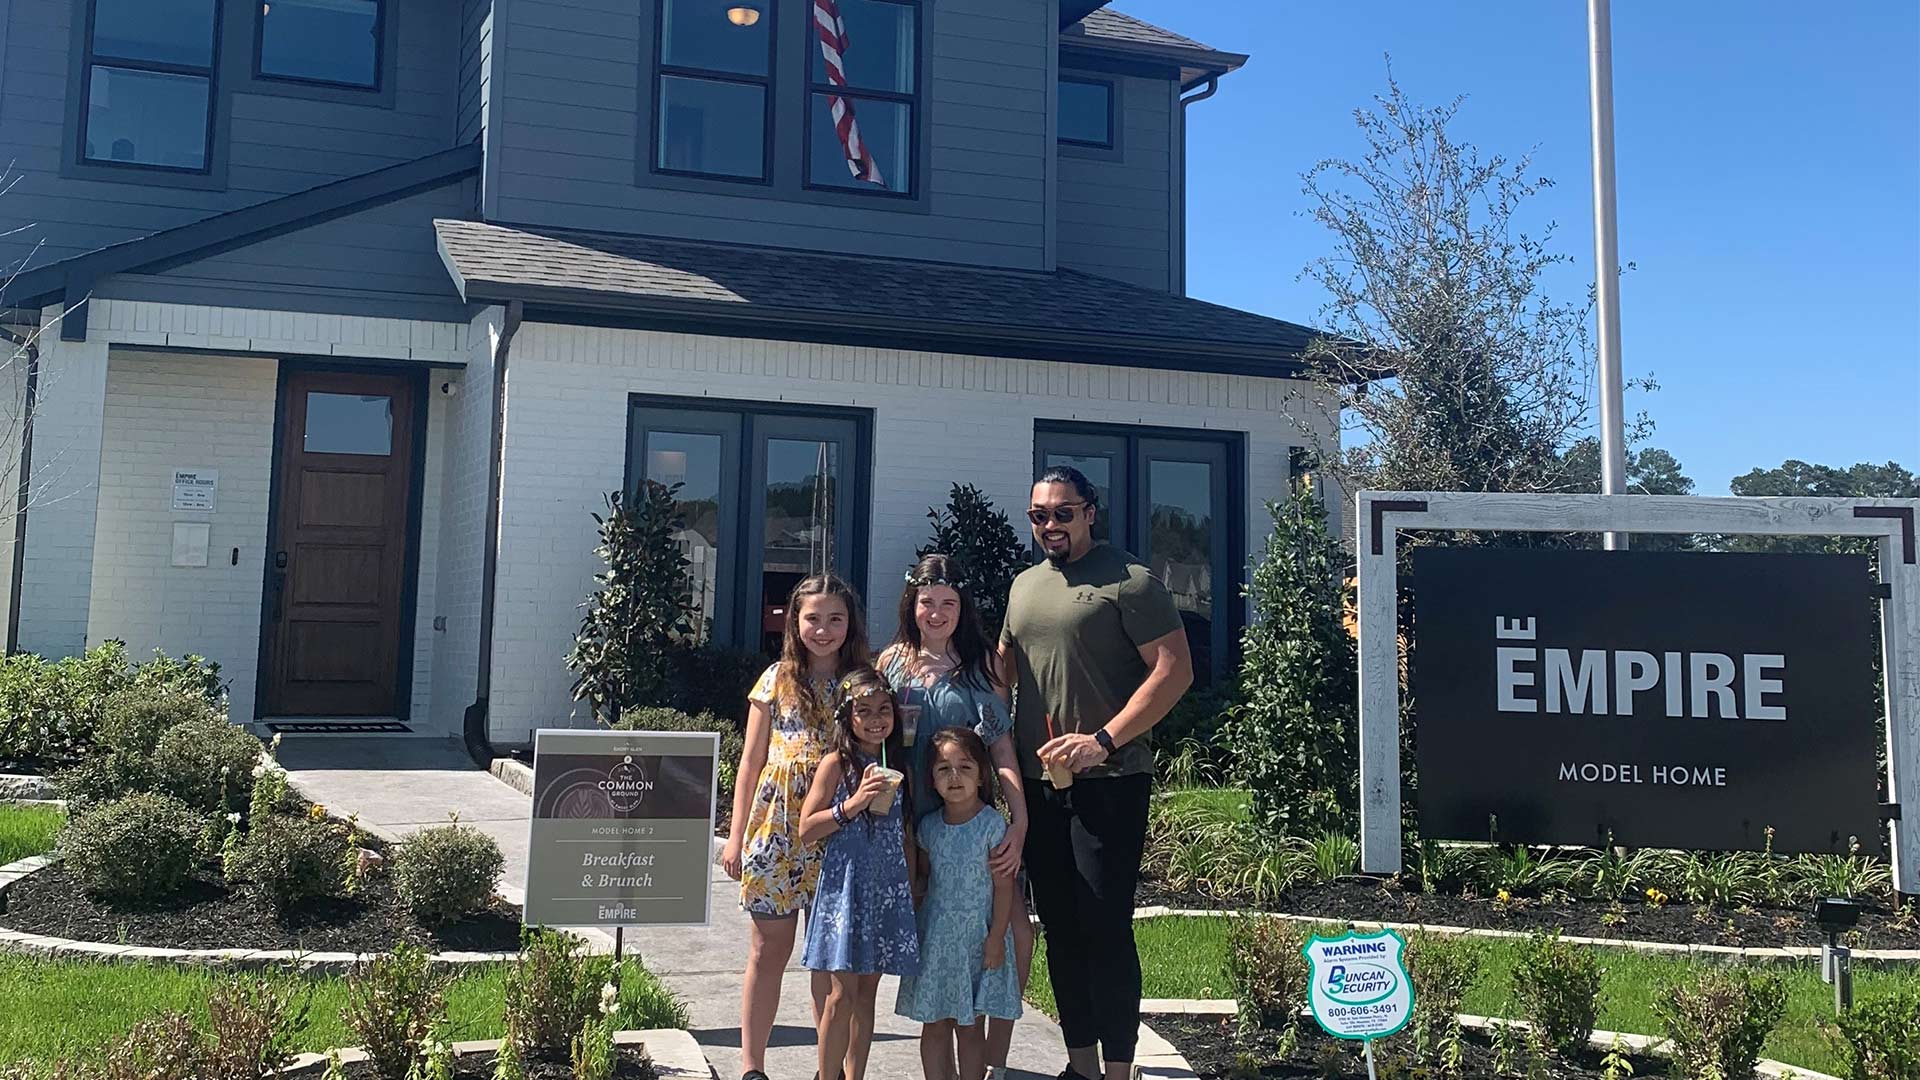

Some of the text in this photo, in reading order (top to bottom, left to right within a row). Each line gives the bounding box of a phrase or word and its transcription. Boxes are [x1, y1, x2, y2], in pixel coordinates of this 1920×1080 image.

[1497, 646, 1787, 721] EMPIRE
[1558, 762, 1727, 787] MODEL HOME
[598, 780, 654, 791] COMMON
[592, 827, 654, 835] MODEL HOME 2
[582, 853, 655, 868] Breakfast
[582, 873, 653, 887] & Brunch
[598, 907, 637, 920] EMPIRE
[1322, 942, 1386, 957] WARNING
[1328, 965, 1385, 984] DUNCAN
[1329, 974, 1391, 994] SECURITY
[1328, 1003, 1397, 1018] 800-606-3491
